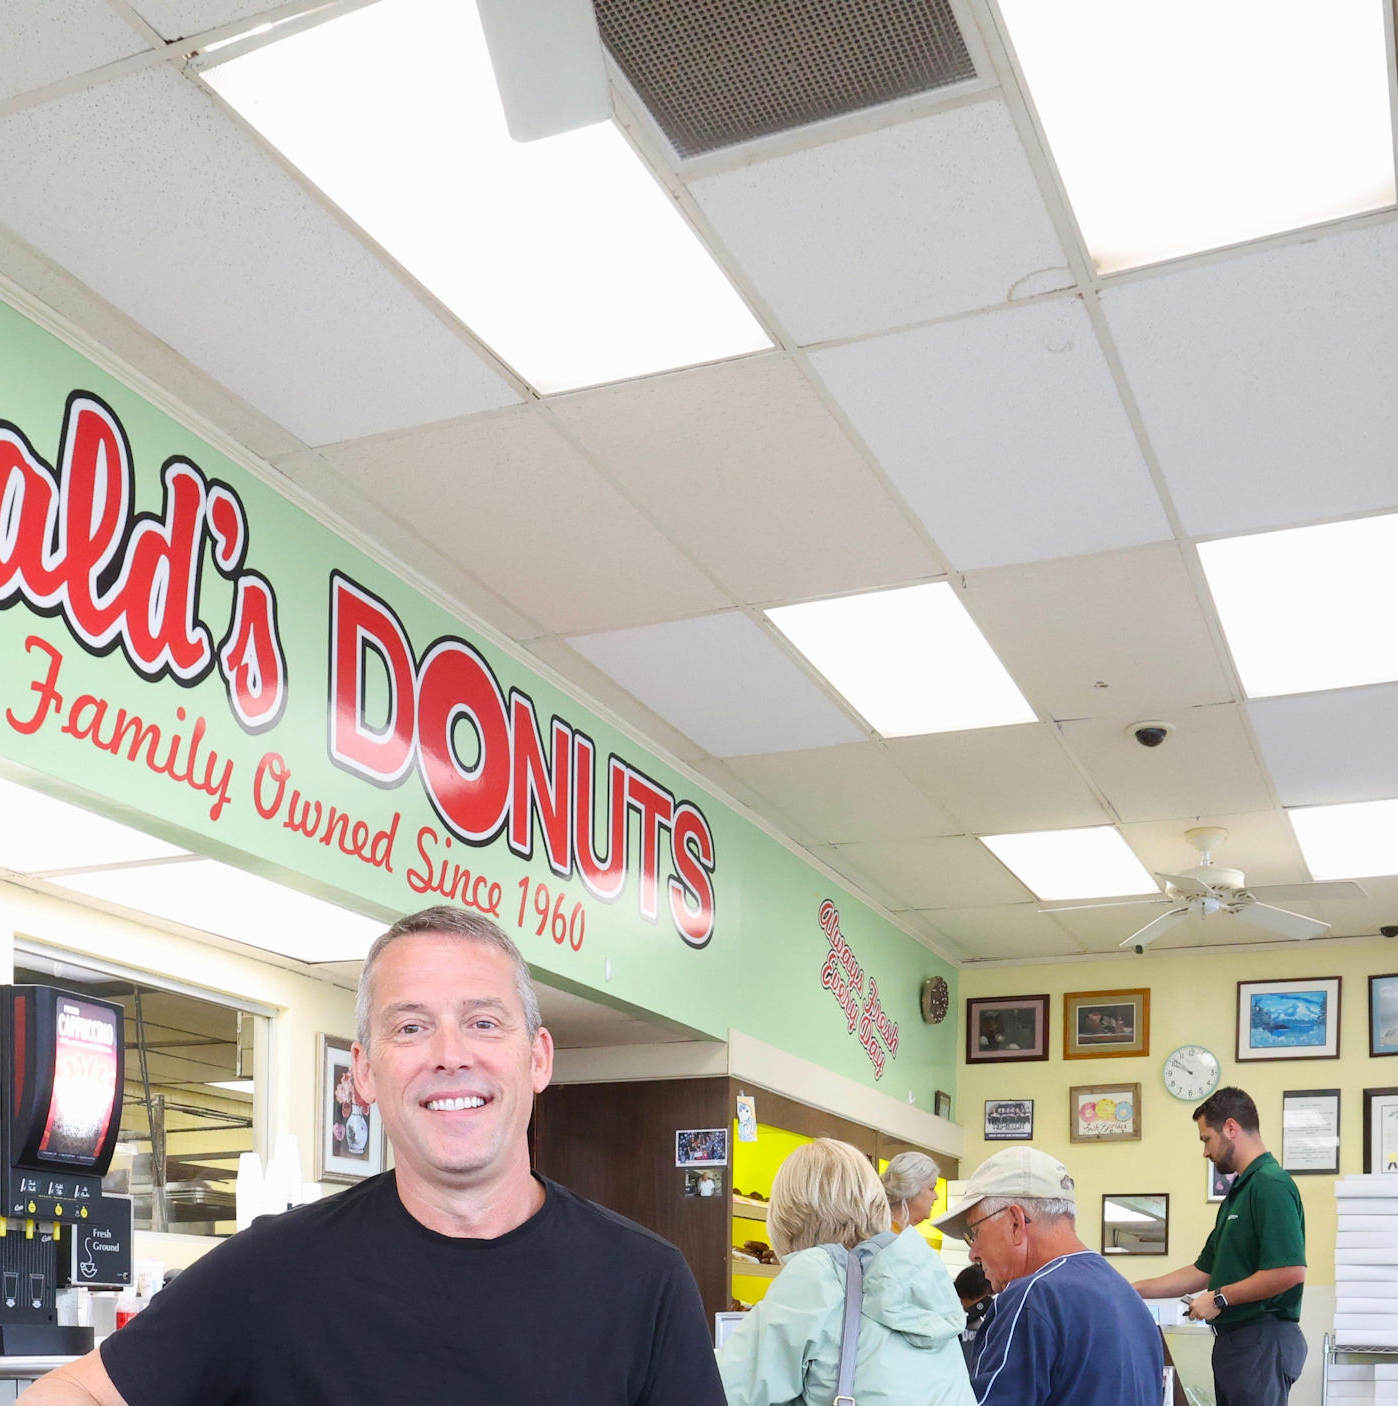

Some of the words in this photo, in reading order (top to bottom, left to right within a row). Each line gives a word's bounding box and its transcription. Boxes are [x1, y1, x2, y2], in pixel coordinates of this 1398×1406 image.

[5, 634, 234, 822] Family
[253, 751, 401, 874] Owned
[406, 825, 501, 919] Since
[516, 875, 586, 953] 1960
[327, 568, 715, 951] DONUTS
[818, 898, 864, 999] Always
[863, 976, 899, 1060] Fresh
[820, 948, 859, 1035] Every
[859, 1012, 886, 1082] Day
[92, 1228, 112, 1239] Fresh
[92, 1241, 120, 1252] Ground
